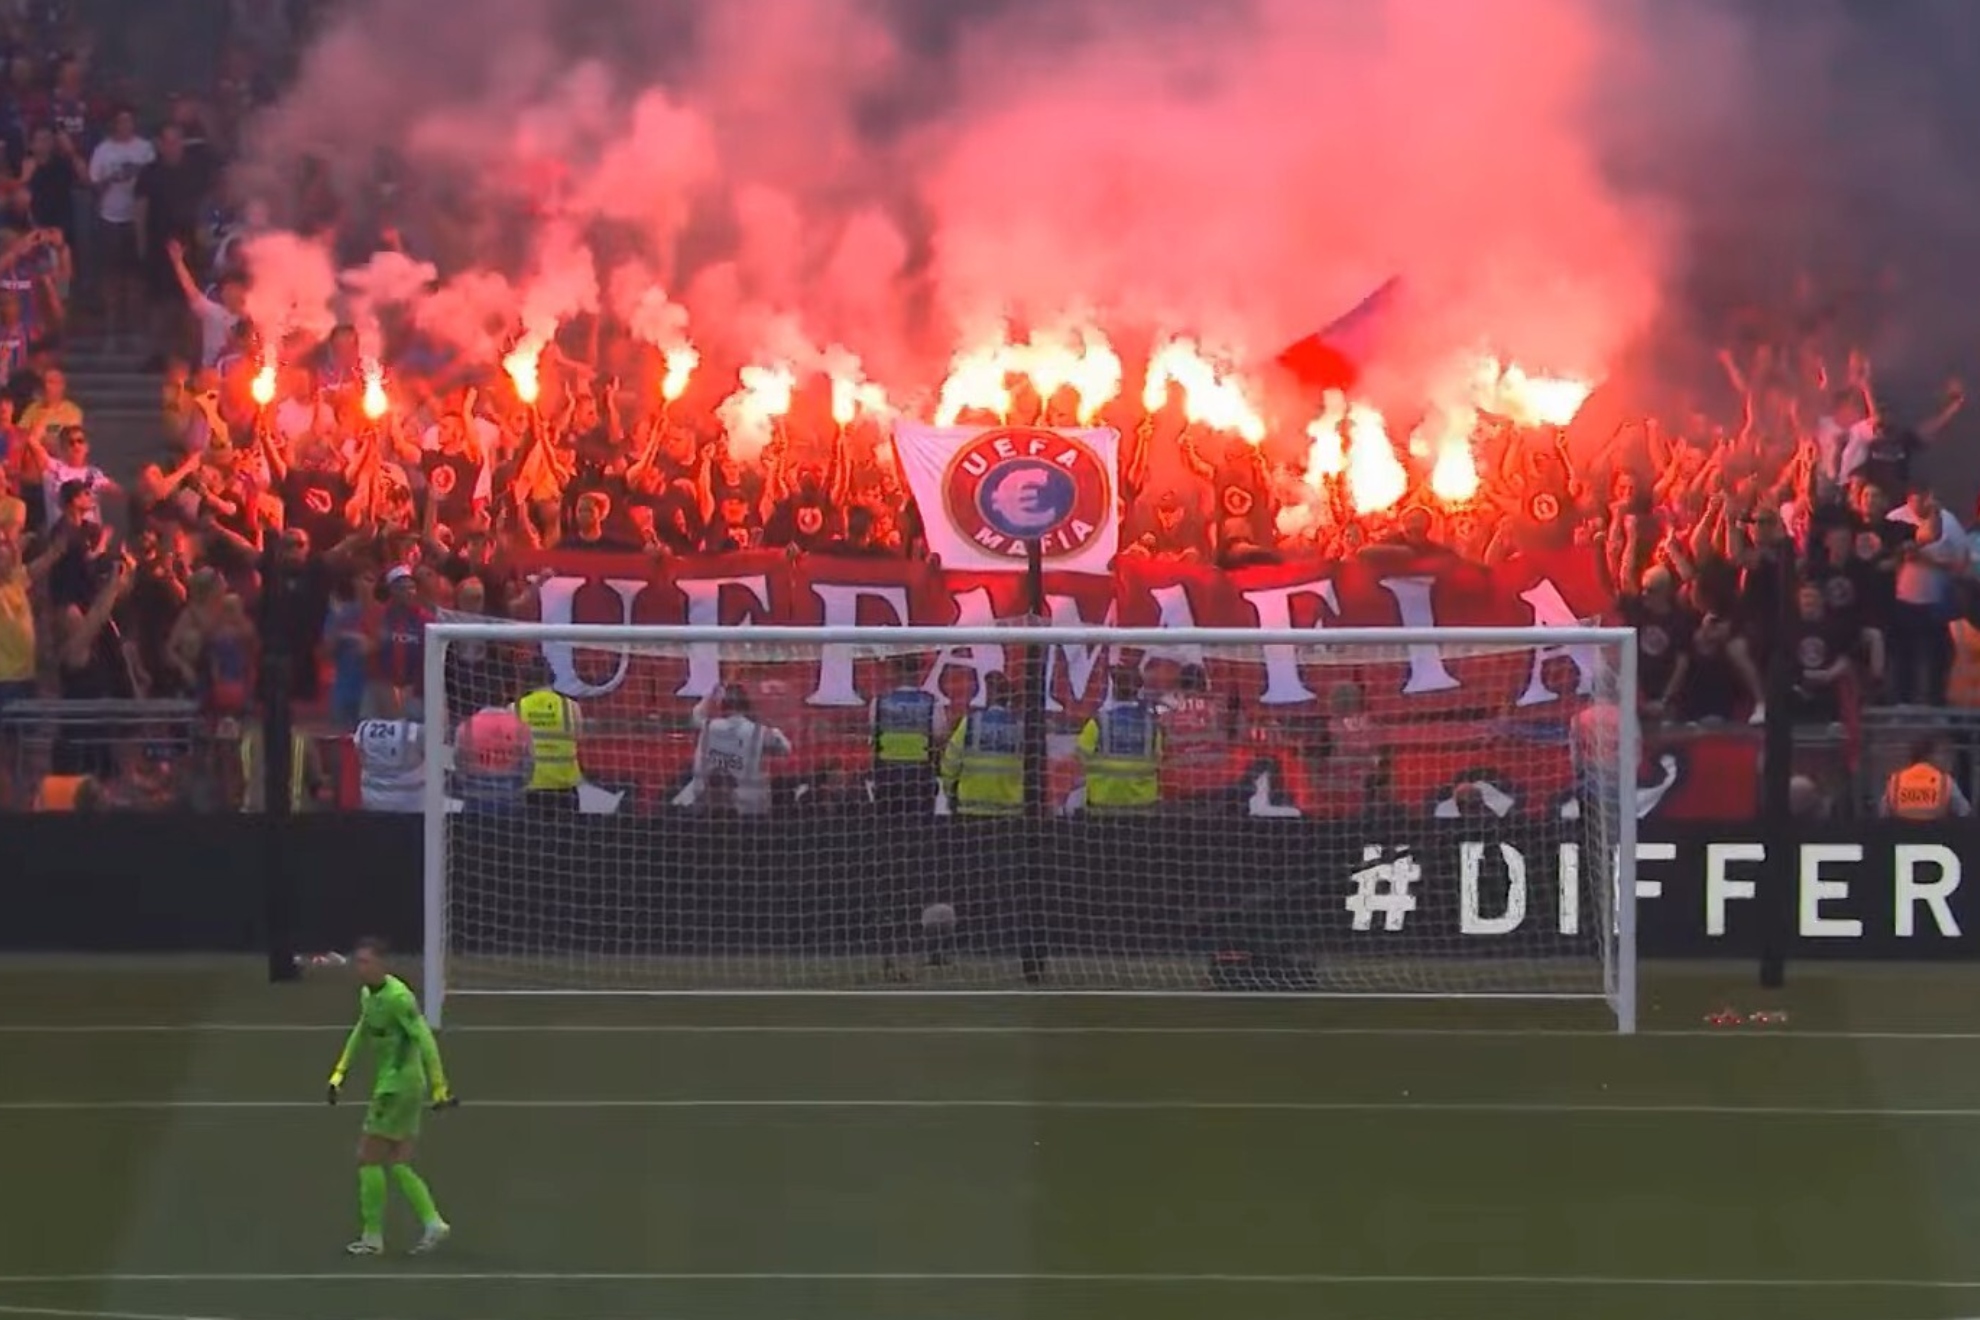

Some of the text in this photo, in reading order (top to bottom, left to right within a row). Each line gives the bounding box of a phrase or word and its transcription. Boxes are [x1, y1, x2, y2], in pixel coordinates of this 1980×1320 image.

[961, 437, 1079, 477] UEFA
[974, 519, 1095, 556] MAFIA
[369, 722, 396, 739] 224
[1345, 842, 1963, 938] #DIFFER
